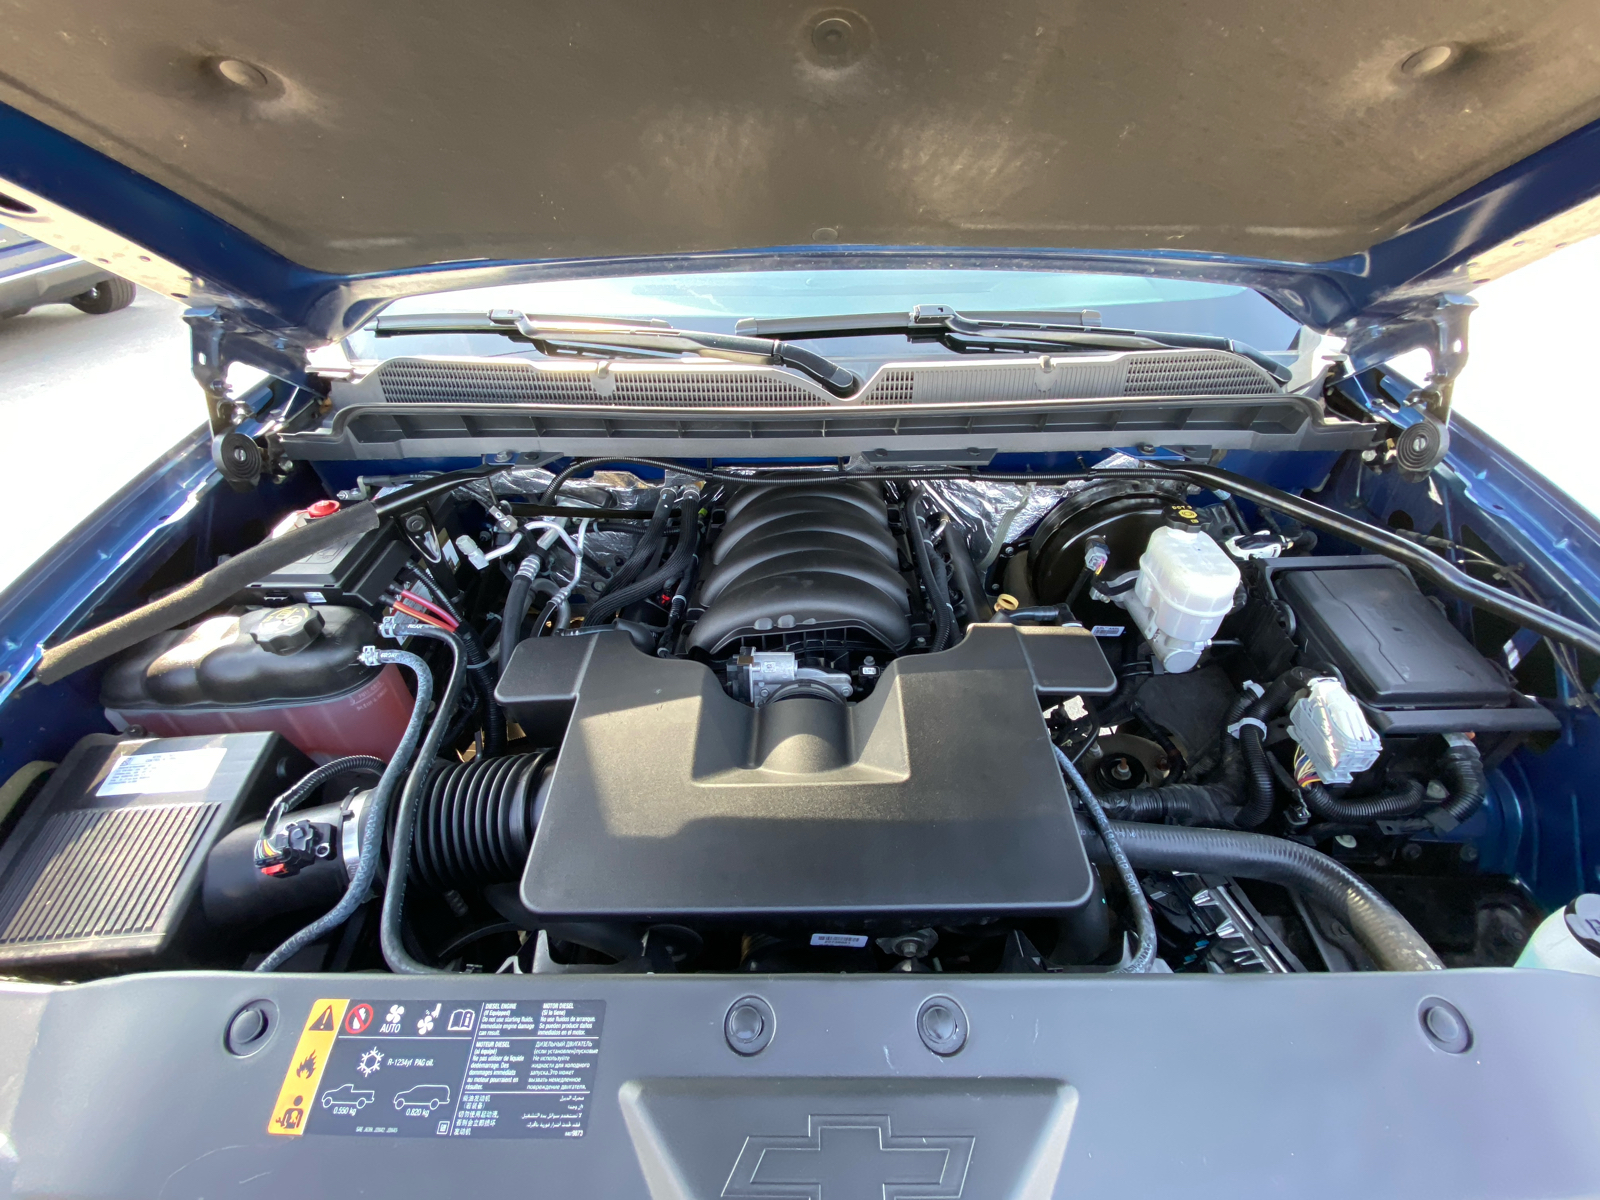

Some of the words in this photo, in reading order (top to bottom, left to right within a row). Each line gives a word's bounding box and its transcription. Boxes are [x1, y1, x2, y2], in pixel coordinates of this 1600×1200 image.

[379, 1023, 401, 1033] AUTO
[387, 1058, 413, 1068] R-1234yf
[413, 1058, 426, 1067] PAG
[333, 1106, 349, 1115] 0.550
[348, 1107, 357, 1116] kg
[405, 1107, 422, 1117] 0.820
[421, 1108, 430, 1118] kg
